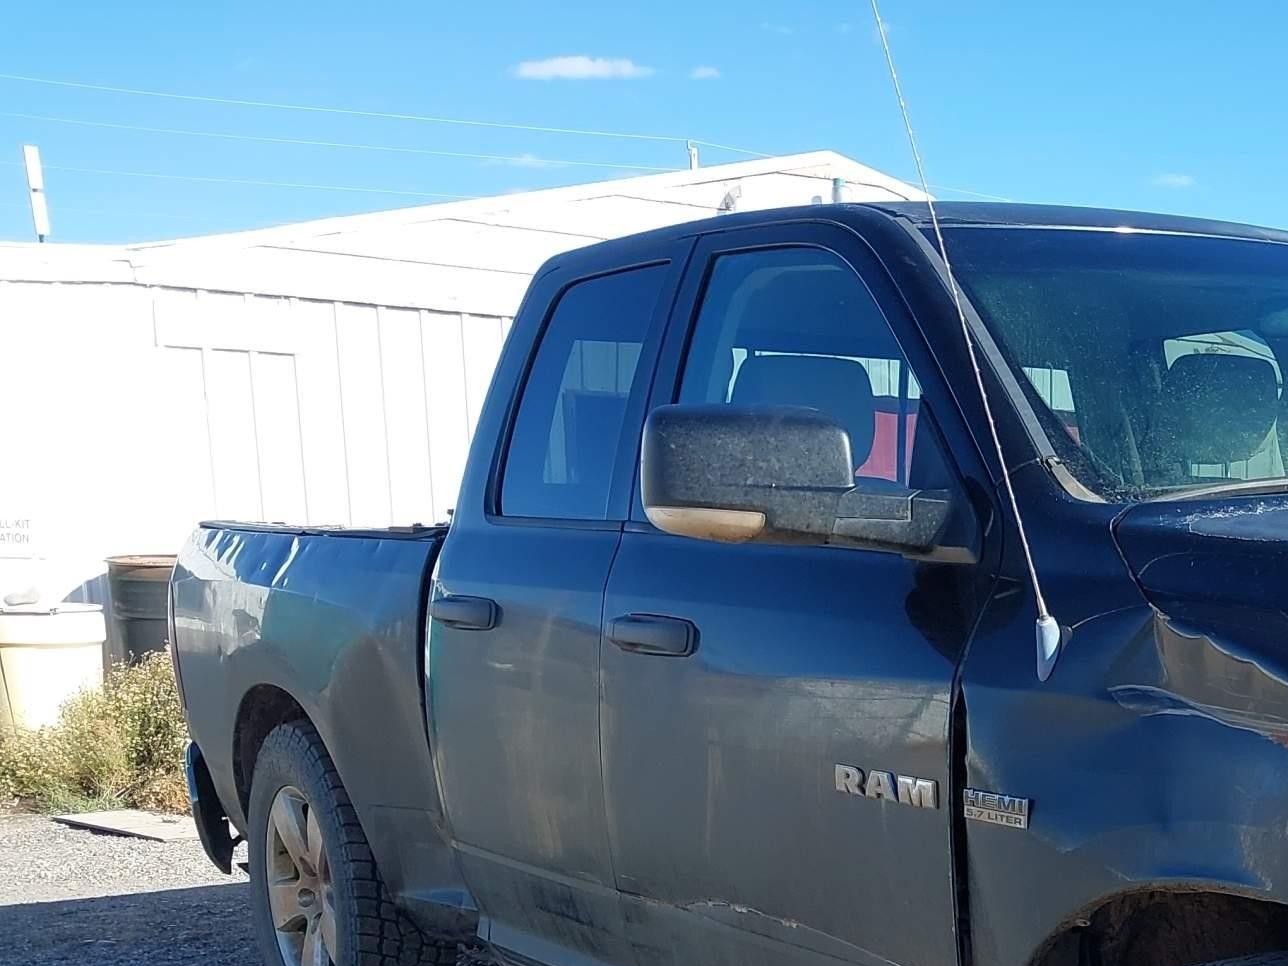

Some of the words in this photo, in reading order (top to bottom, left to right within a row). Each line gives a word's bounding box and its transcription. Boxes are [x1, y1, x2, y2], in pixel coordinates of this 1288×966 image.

[835, 764, 939, 809] RAM
[964, 789, 1028, 815] HEMI
[966, 808, 984, 818] 5.7
[987, 812, 1022, 826] LITER
